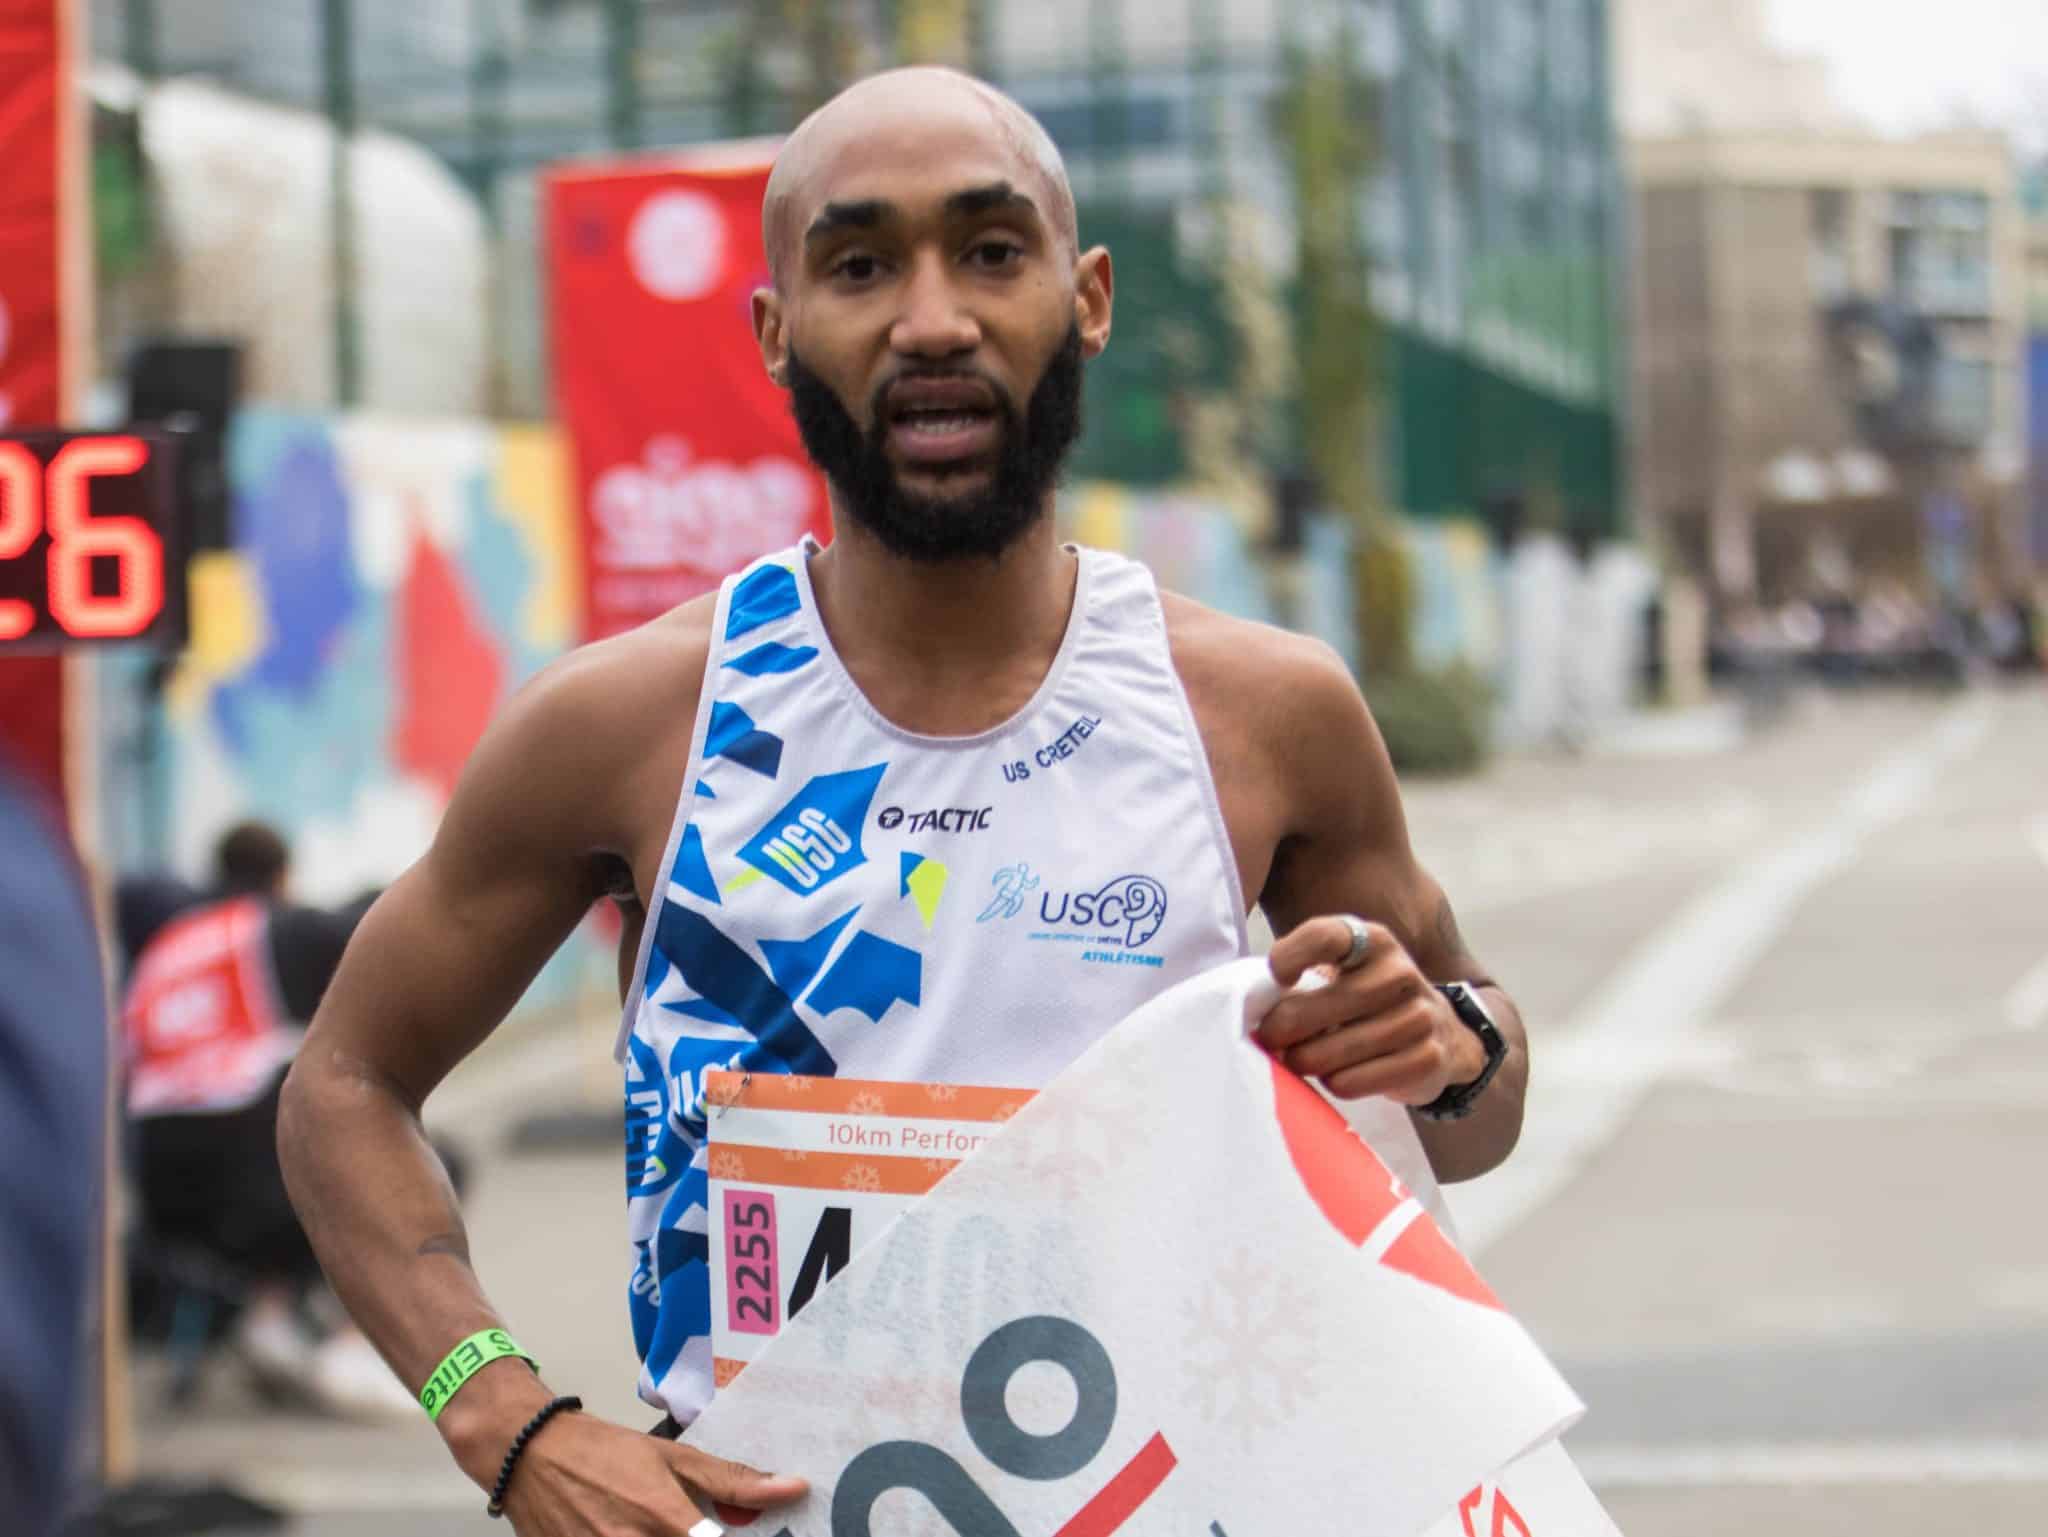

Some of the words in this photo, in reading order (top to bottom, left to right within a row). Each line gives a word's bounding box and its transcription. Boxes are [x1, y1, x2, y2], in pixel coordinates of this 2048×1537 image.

[1002, 761, 1031, 783] US
[908, 806, 992, 834] TACTIC
[761, 808, 852, 888] USC
[1040, 891, 1125, 928] USC
[828, 1123, 891, 1146] 10km
[734, 1202, 773, 1325] 2255
[423, 1341, 484, 1410] Elite
